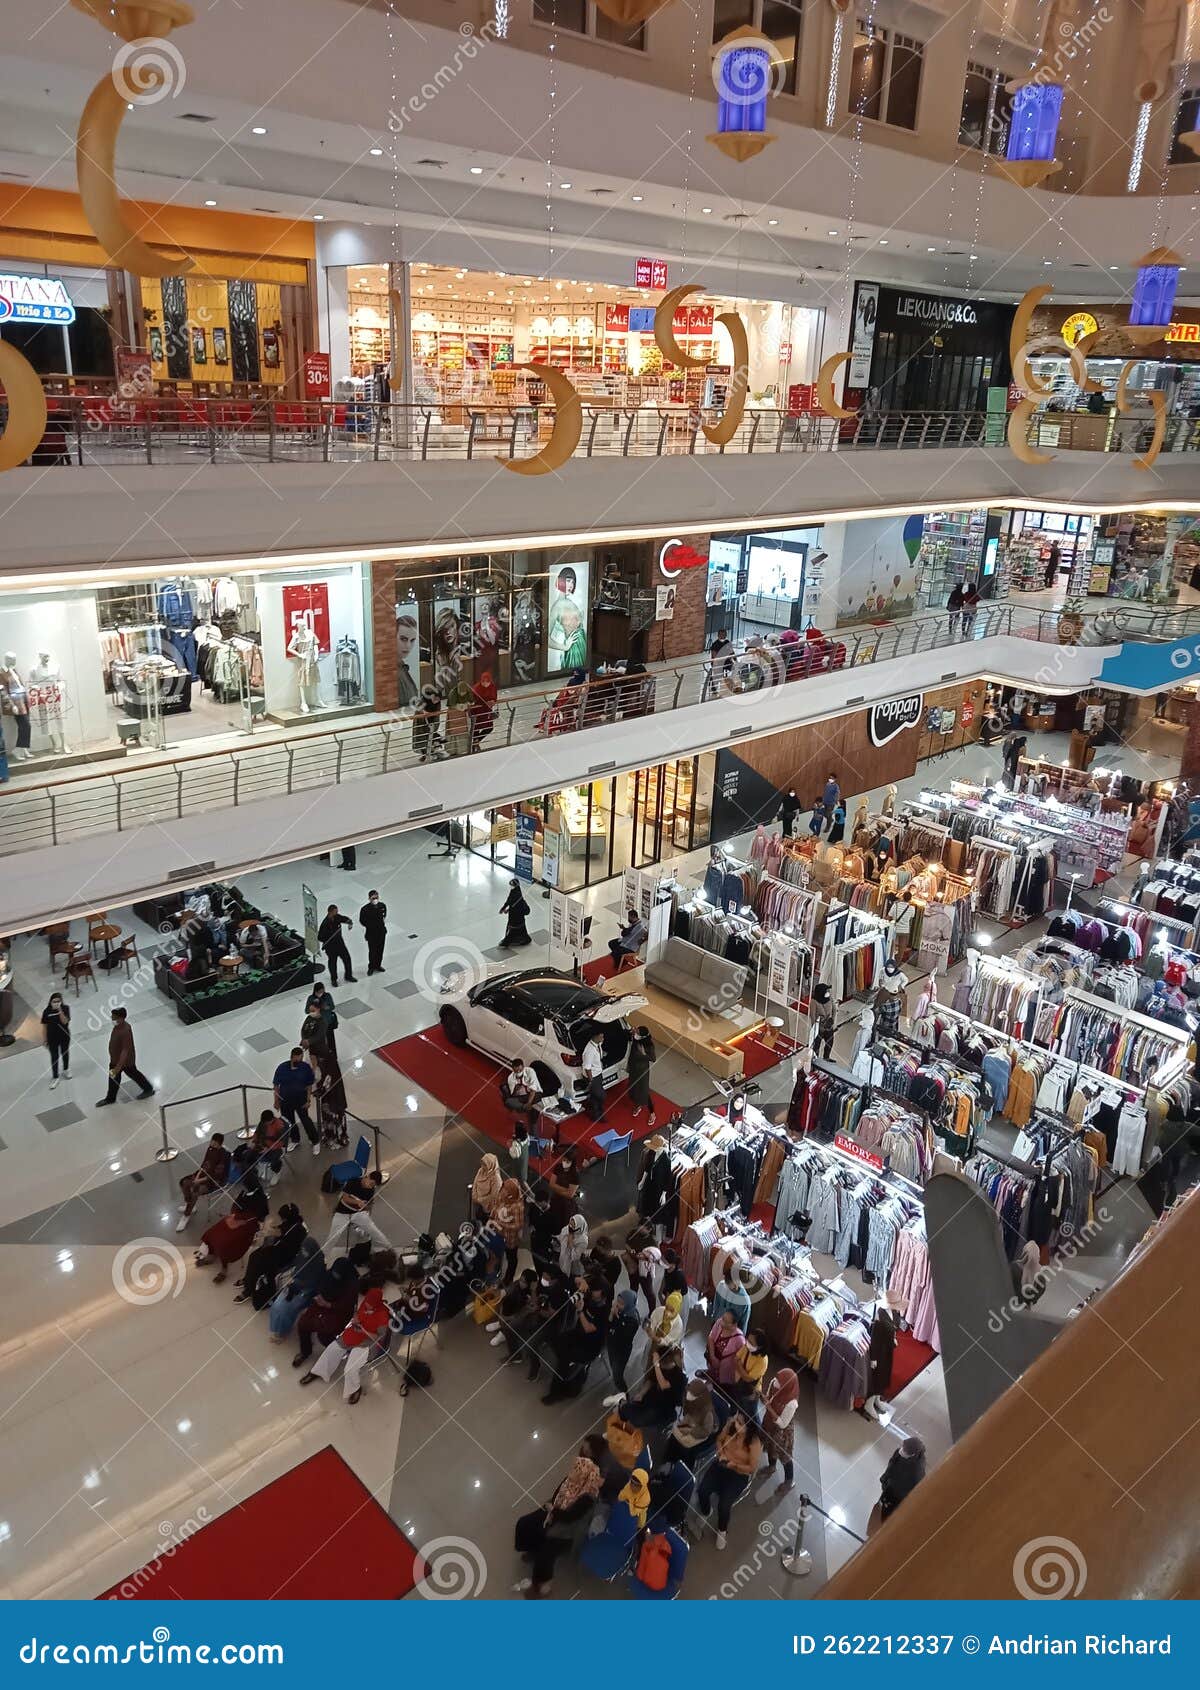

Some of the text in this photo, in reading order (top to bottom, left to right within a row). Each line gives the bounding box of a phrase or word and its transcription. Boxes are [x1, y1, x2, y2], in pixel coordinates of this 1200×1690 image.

[606, 313, 628, 325] SALE
[672, 317, 687, 327] ALE
[690, 317, 712, 327] SALE
[307, 370, 329, 385] 30%
[876, 697, 919, 721] roppan
[838, 1136, 872, 1160] EMORY
